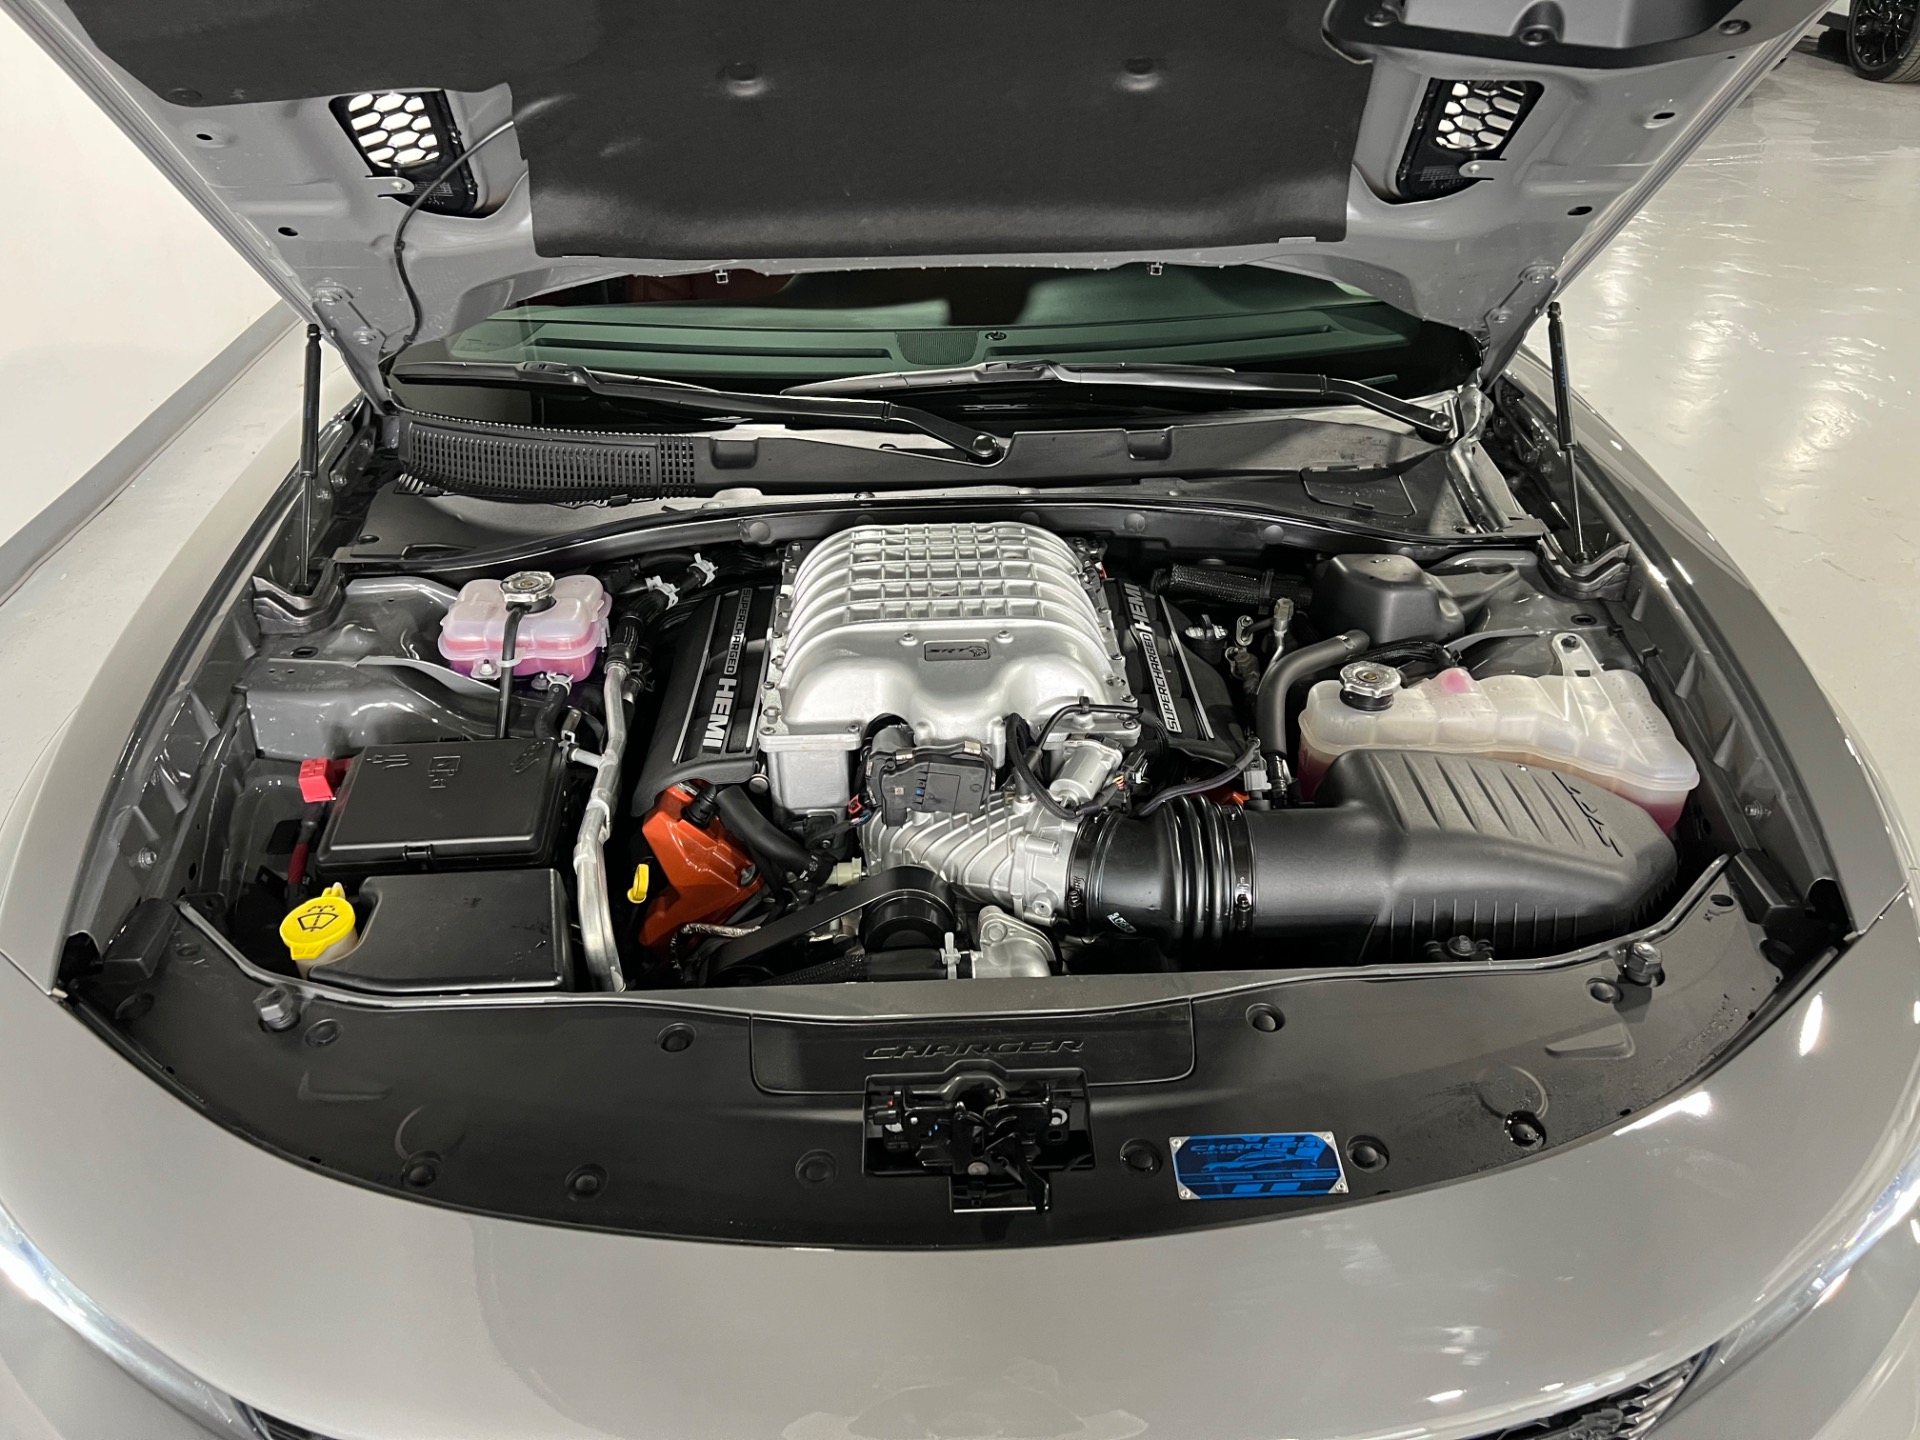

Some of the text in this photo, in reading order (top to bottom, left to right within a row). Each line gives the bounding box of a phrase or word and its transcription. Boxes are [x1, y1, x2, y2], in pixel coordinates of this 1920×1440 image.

[702, 588, 752, 749] SUPERCHARGED HEMI
[1124, 582, 1182, 733] SUPERCHARGED HEMI
[864, 1040, 1084, 1060] CHARGER
[1189, 1140, 1321, 1153] CHARGER
